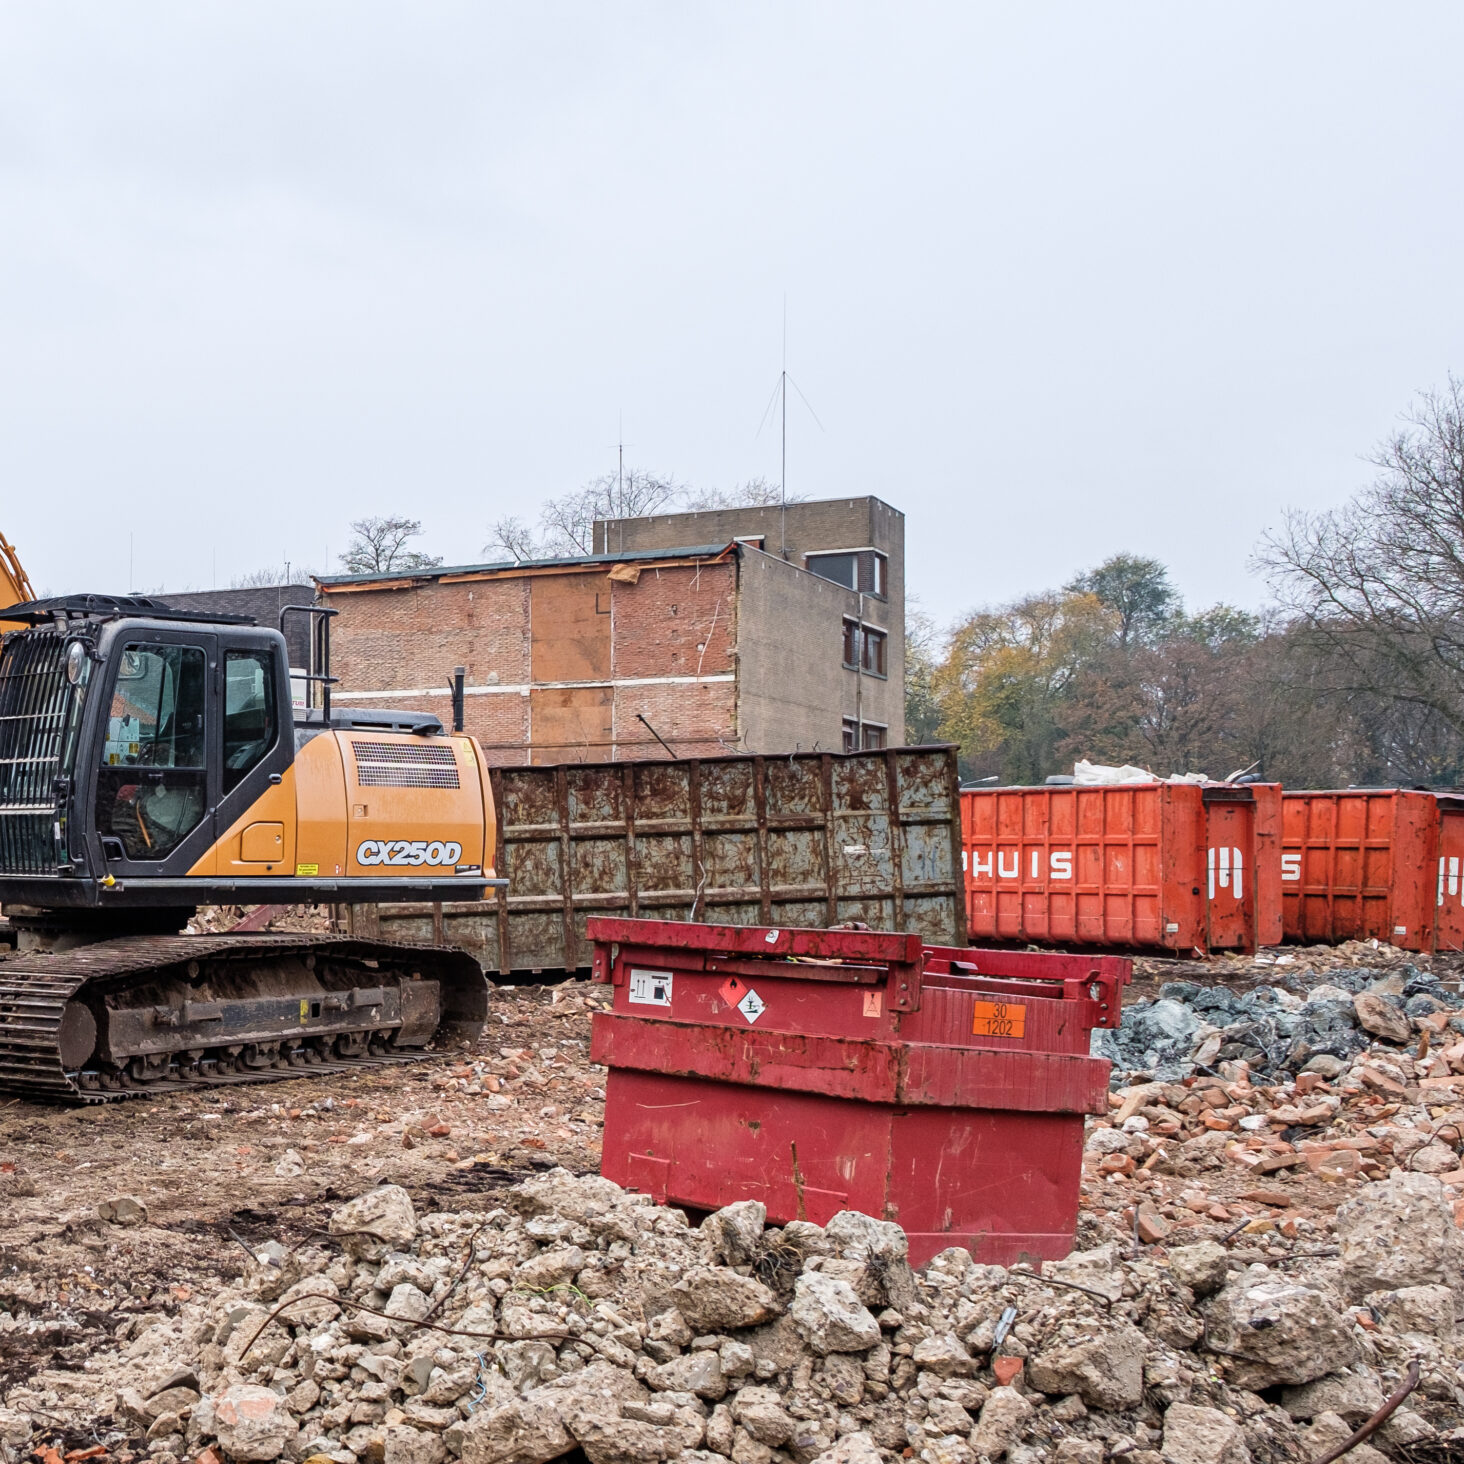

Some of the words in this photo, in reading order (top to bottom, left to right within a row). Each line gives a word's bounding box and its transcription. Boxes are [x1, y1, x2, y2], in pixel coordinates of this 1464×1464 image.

[356, 839, 462, 866] CX250D
[993, 1003, 1007, 1018] 30
[986, 1020, 1013, 1036] 1202
